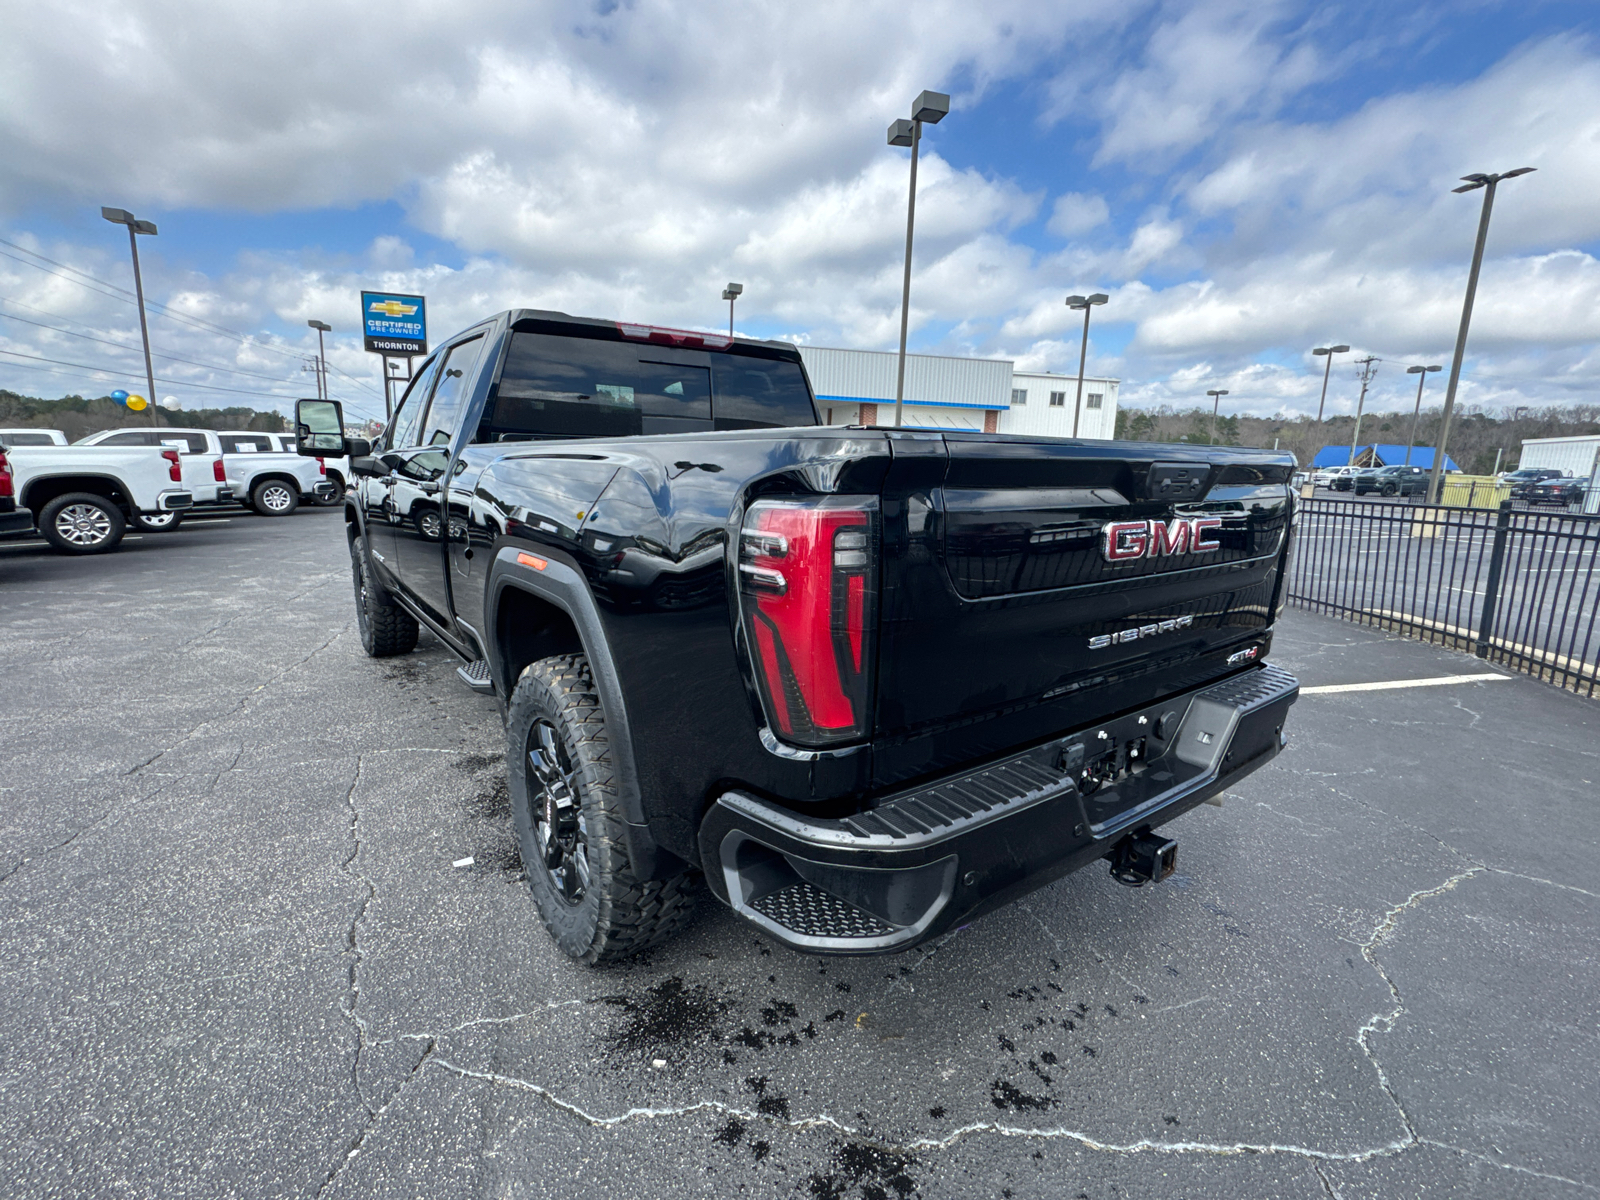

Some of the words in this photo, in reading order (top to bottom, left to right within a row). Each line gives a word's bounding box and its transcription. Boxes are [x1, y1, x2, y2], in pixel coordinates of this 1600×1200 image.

[367, 319, 421, 330] CERTIFIED
[370, 326, 419, 335] PRE-OWNED
[373, 341, 419, 351] THORNTON
[1101, 517, 1222, 563] GMC
[1087, 614, 1194, 650] SIERRA
[1226, 645, 1258, 666] AT4
